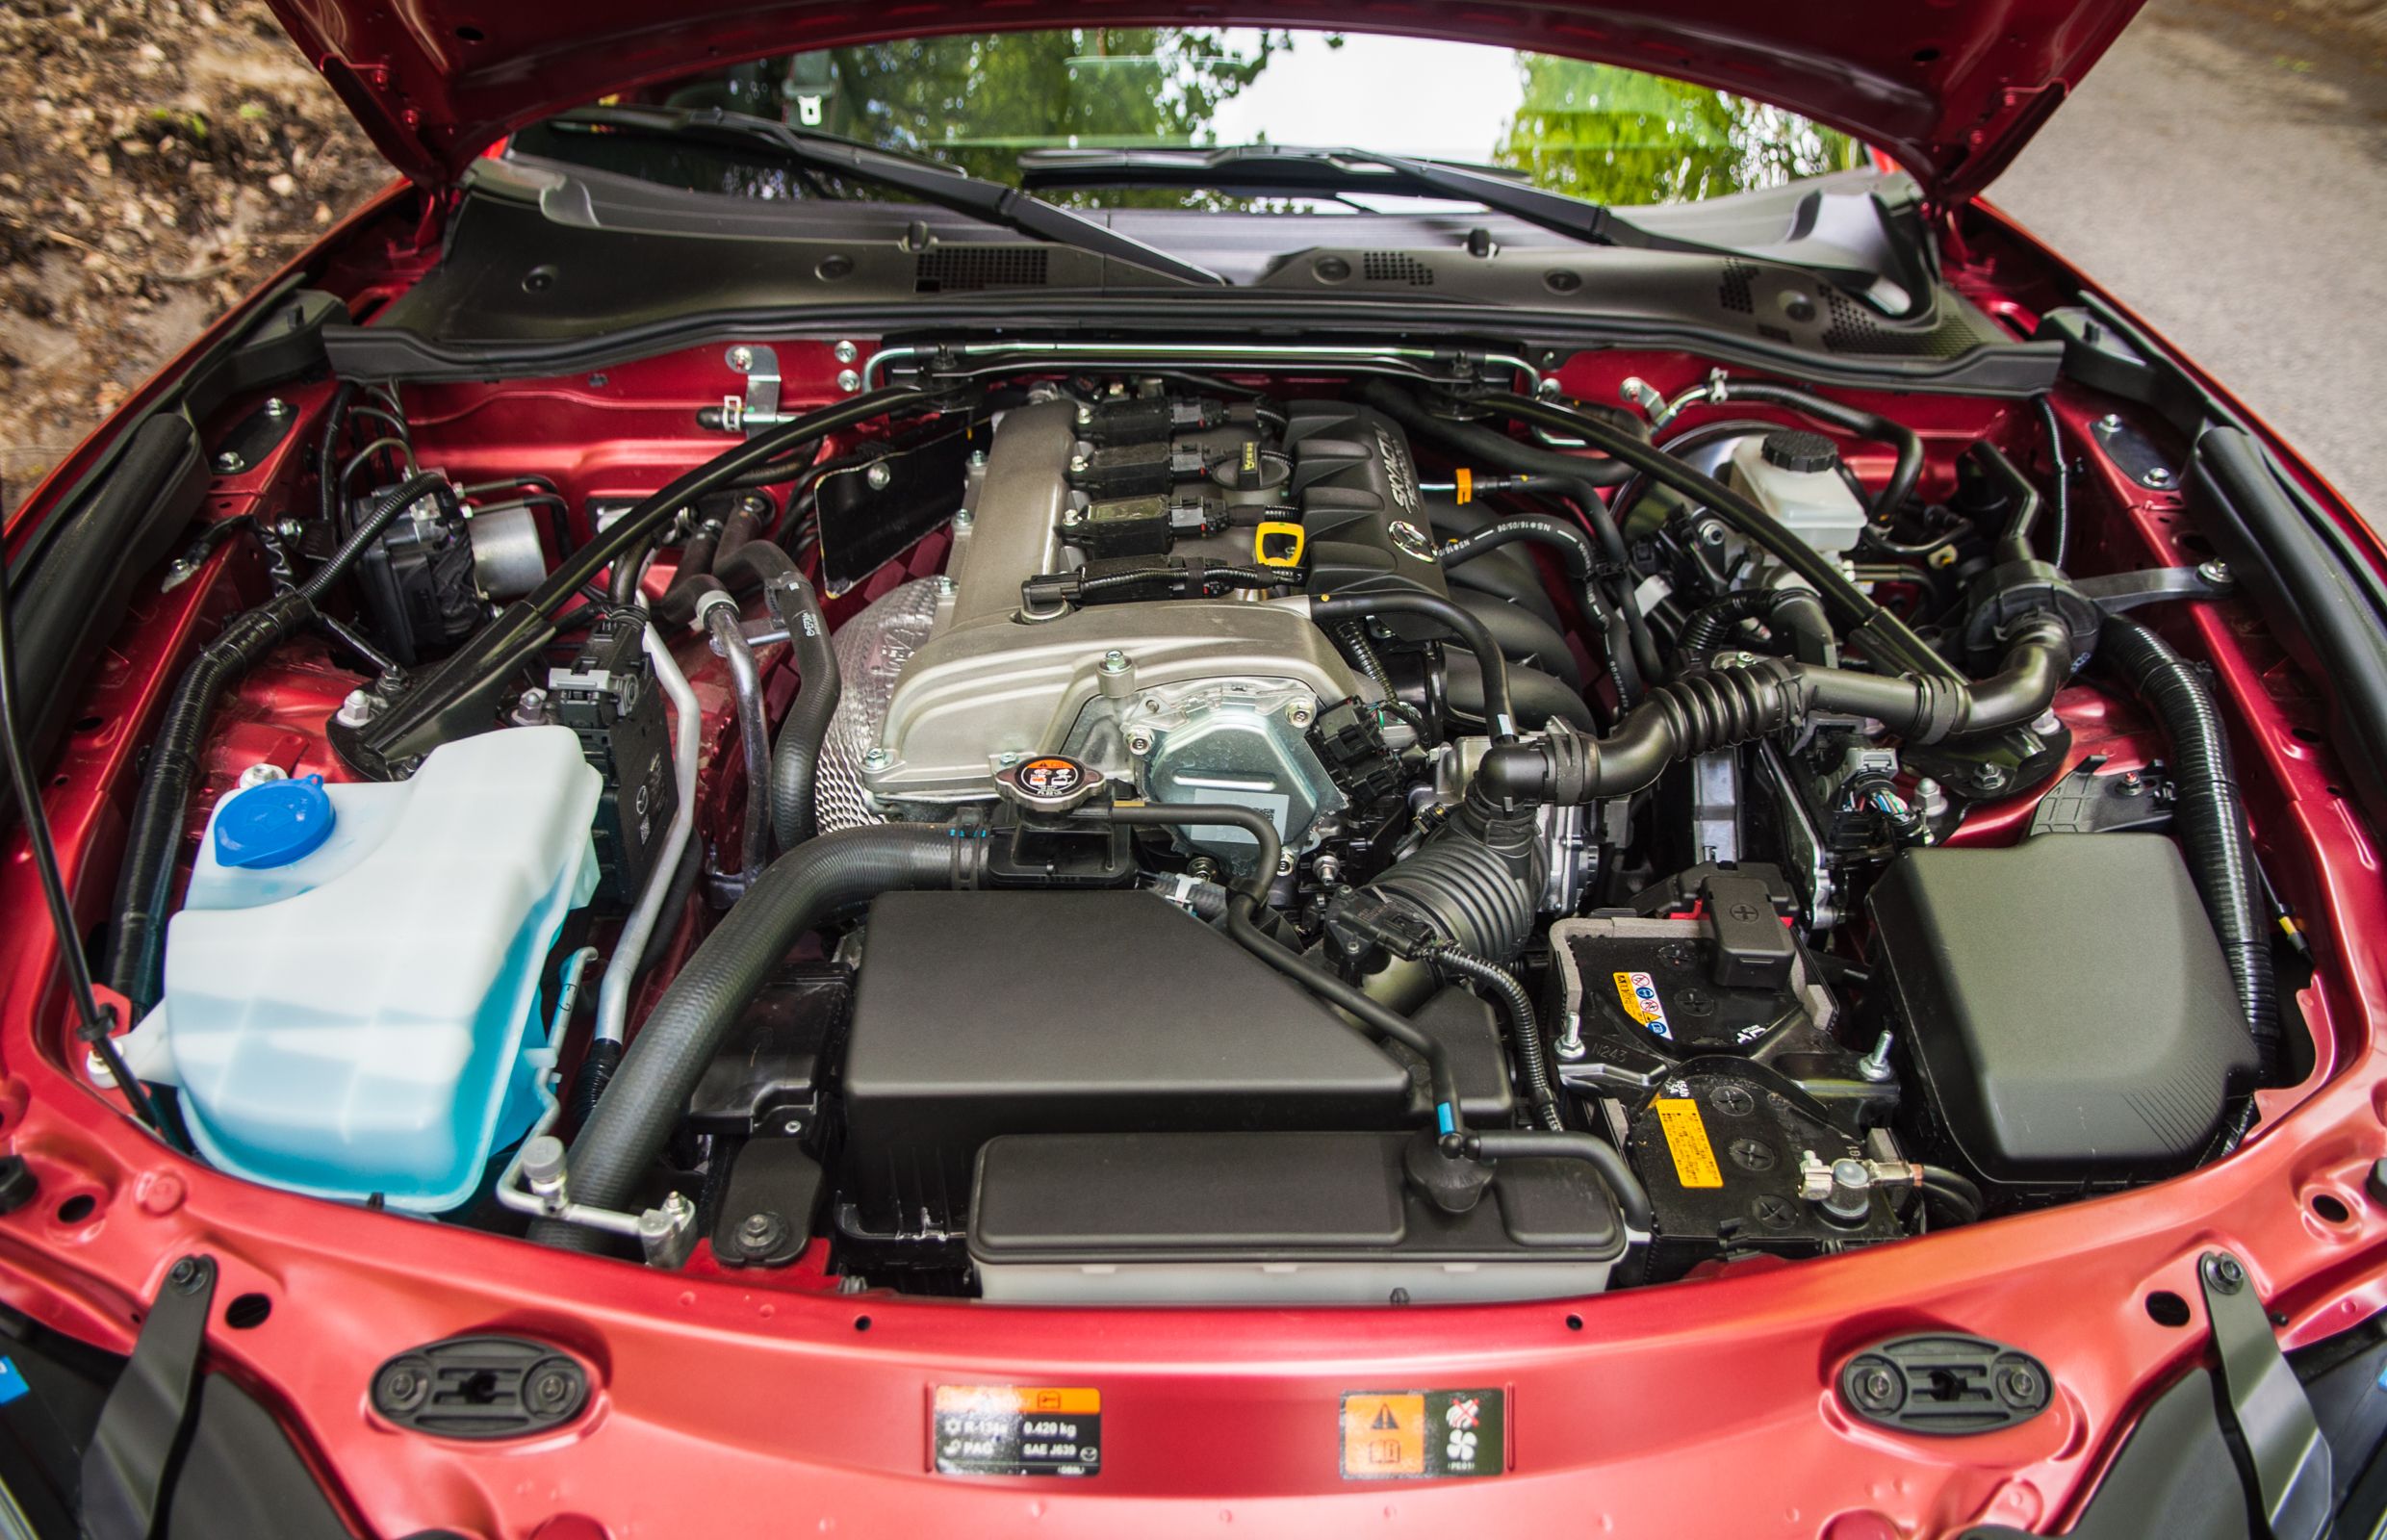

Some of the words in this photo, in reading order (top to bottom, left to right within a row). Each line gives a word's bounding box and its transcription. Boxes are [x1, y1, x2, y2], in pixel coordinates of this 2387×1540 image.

[1372, 421, 1412, 514] SKYACTIV
[1023, 1422, 1058, 1435] 0.420
[1060, 1422, 1077, 1438] kg
[1023, 1444, 1048, 1455] SAE
[1050, 1444, 1077, 1456] J639
